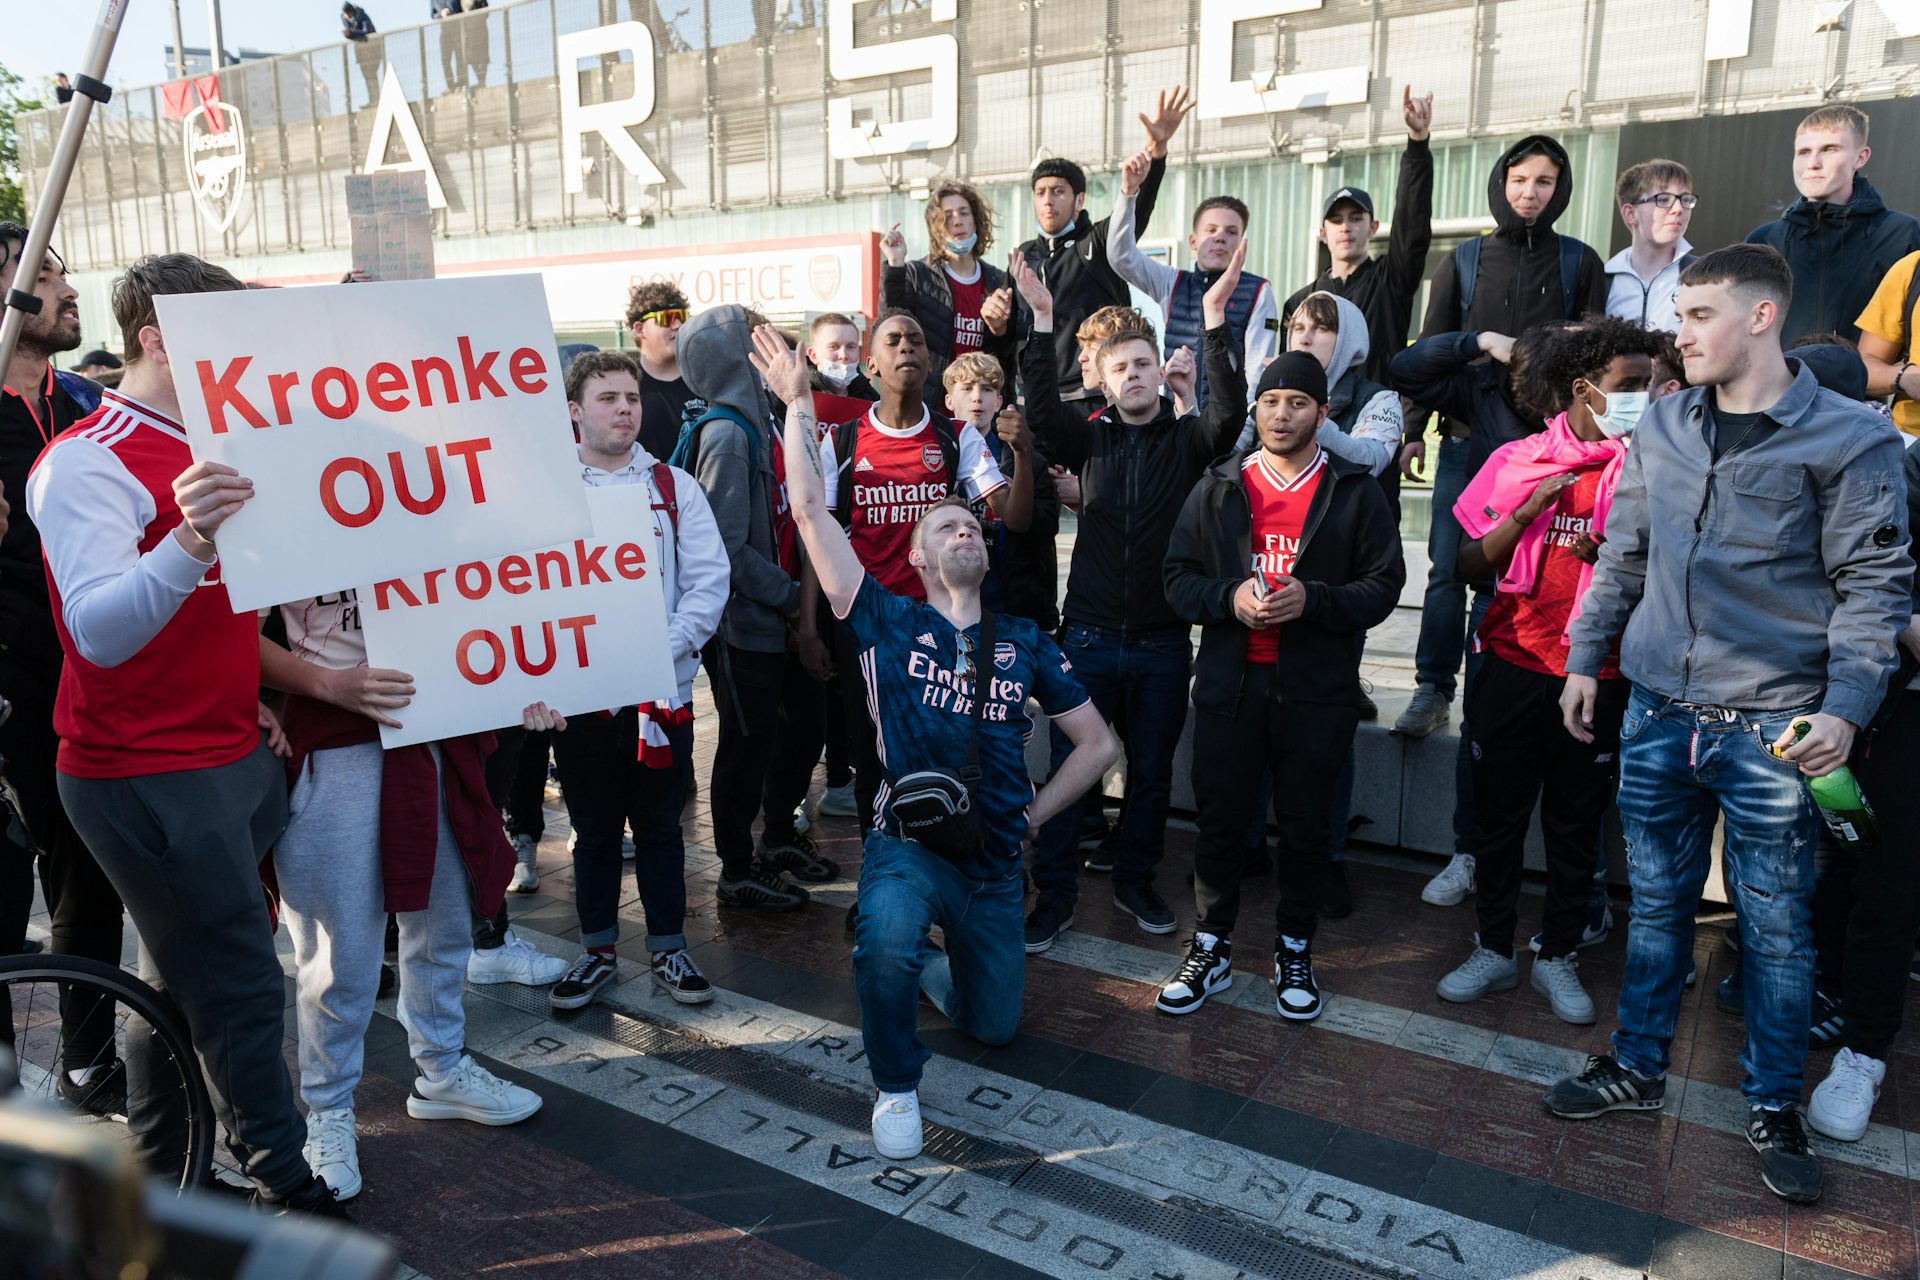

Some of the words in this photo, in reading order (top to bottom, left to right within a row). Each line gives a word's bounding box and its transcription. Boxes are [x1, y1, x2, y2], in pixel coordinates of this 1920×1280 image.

[695, 264, 795, 304] OFFICE
[955, 330, 984, 348] BETTE
[195, 335, 549, 435] Kroenke
[318, 437, 492, 528] OUT
[854, 480, 947, 507] Emirates
[867, 506, 887, 525] FLY
[890, 503, 934, 525] BETTE
[1264, 534, 1301, 553] Fly
[1544, 531, 1558, 545] LY
[373, 539, 647, 611] Kroenke
[342, 606, 362, 632] FL
[455, 614, 597, 686] OUT
[922, 684, 952, 709] FLY
[906, 819, 934, 828] adidas
[1804, 1243, 1857, 1263] ARSENAL
[1811, 1237, 1830, 1247] WE
[1833, 1242, 1863, 1257] LOVE
[1866, 1252, 1892, 1265] YOU
